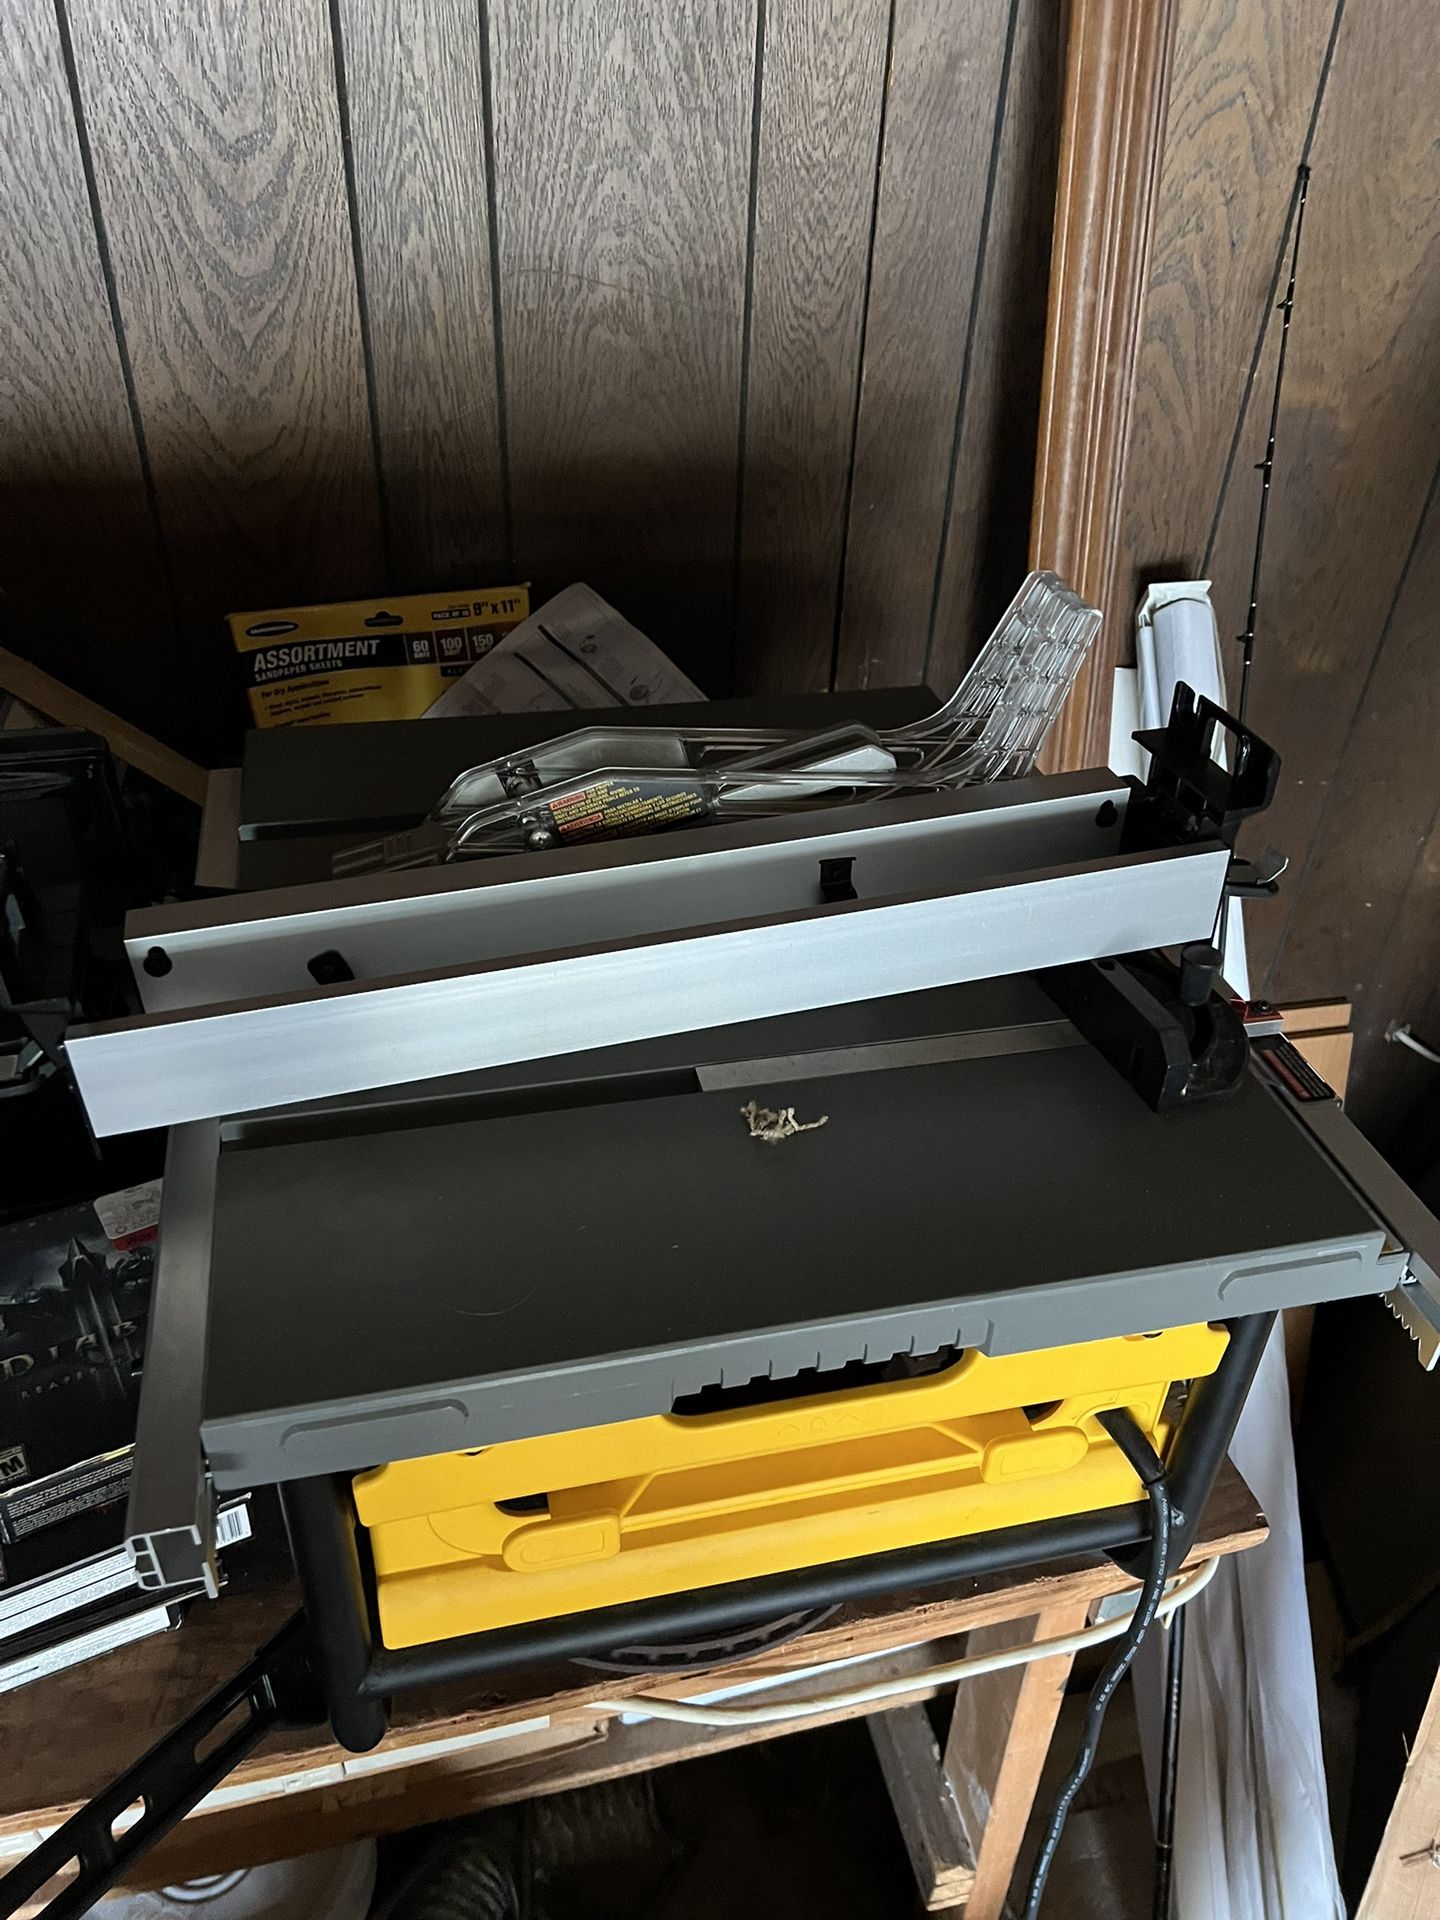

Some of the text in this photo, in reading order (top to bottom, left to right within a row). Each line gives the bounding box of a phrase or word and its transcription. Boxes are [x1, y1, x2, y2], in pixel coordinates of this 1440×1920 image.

[412, 639, 429, 652] 60
[440, 636, 462, 650] 100
[471, 633, 494, 648] 150
[253, 639, 380, 672] ASSORTMENT
[255, 659, 342, 682] SANDPAPER SHEETS
[1, 1320, 138, 1377] DIAB
[21, 1366, 98, 1399] REAPER
[1, 1455, 23, 1477] M
